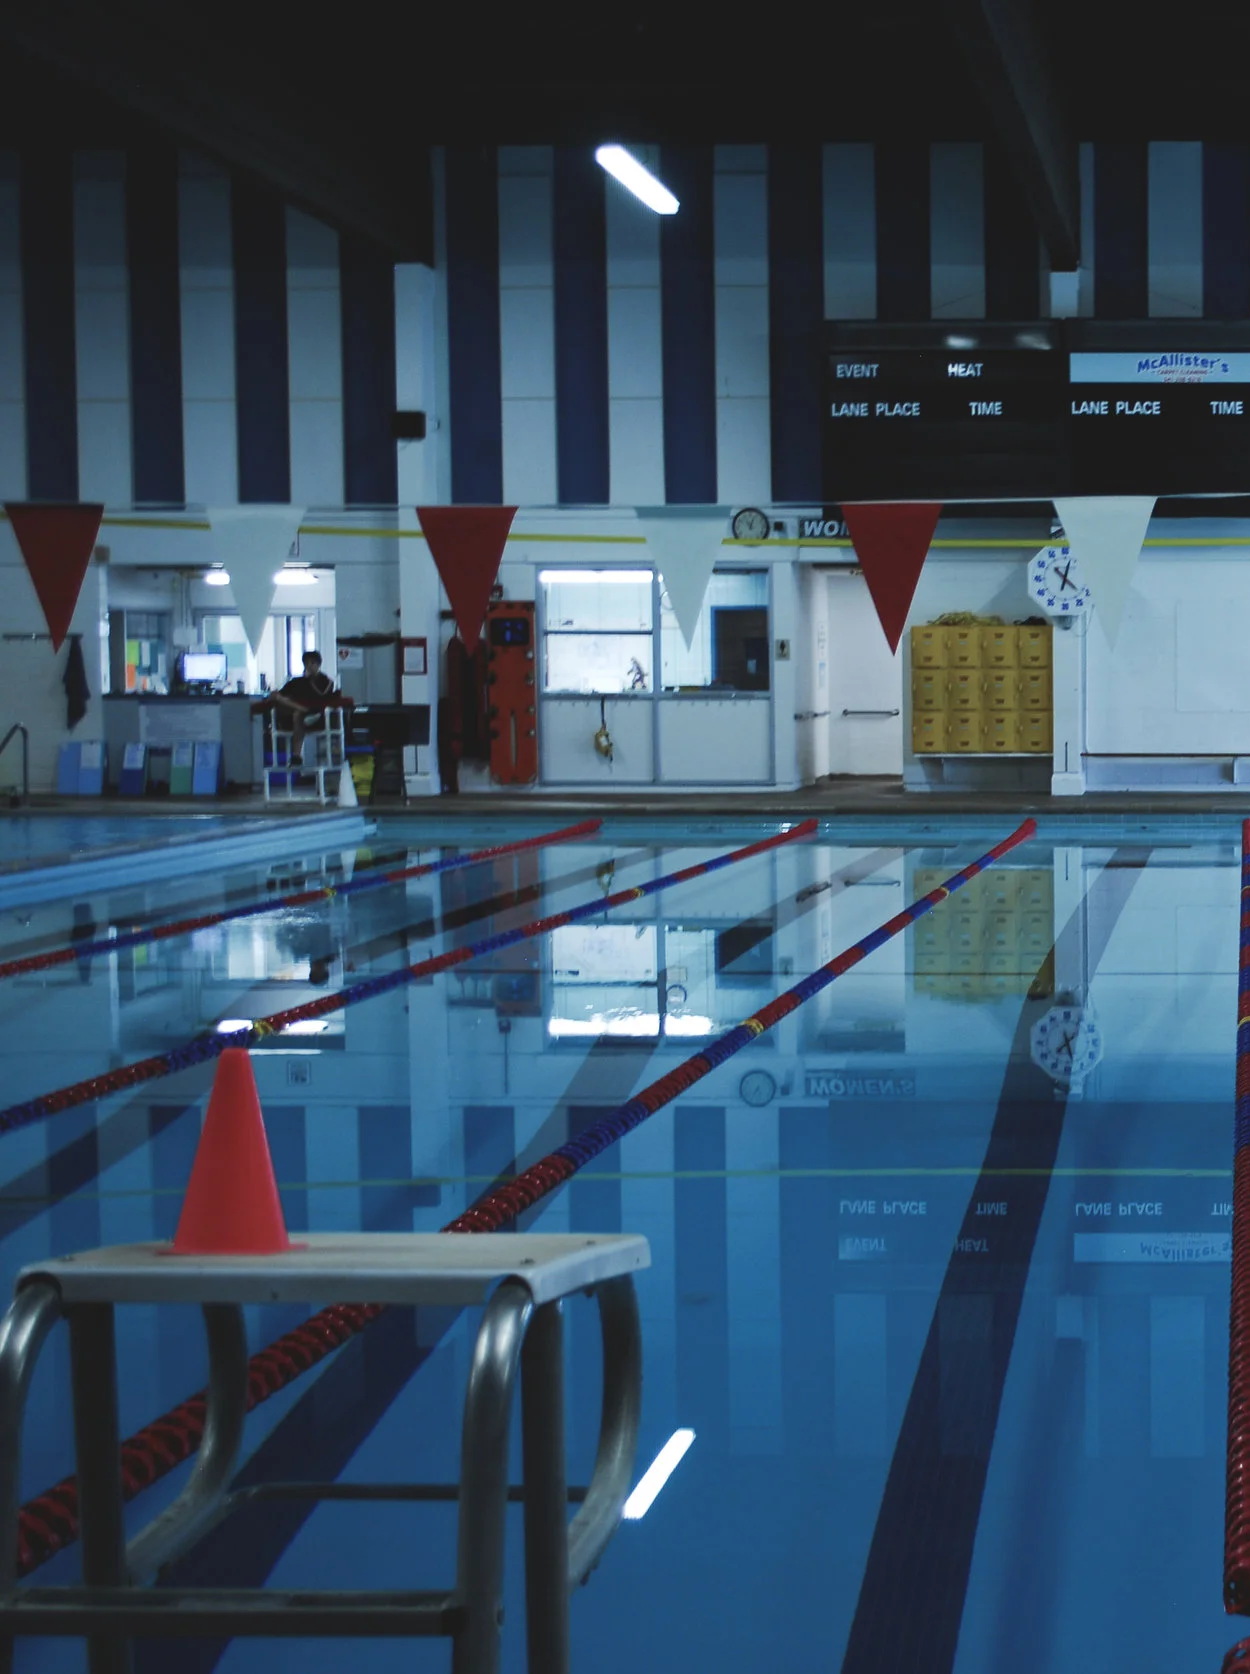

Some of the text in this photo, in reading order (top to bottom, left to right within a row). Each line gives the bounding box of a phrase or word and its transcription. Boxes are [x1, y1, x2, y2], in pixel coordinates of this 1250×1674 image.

[836, 363, 879, 378] EVENT
[947, 363, 983, 377] HEAT
[1137, 353, 1229, 373] McAllister's
[831, 402, 921, 417] LANE PLACE
[969, 401, 1003, 416] TIME
[1071, 400, 1161, 415] LANE PLACE
[1210, 400, 1244, 415] TIME
